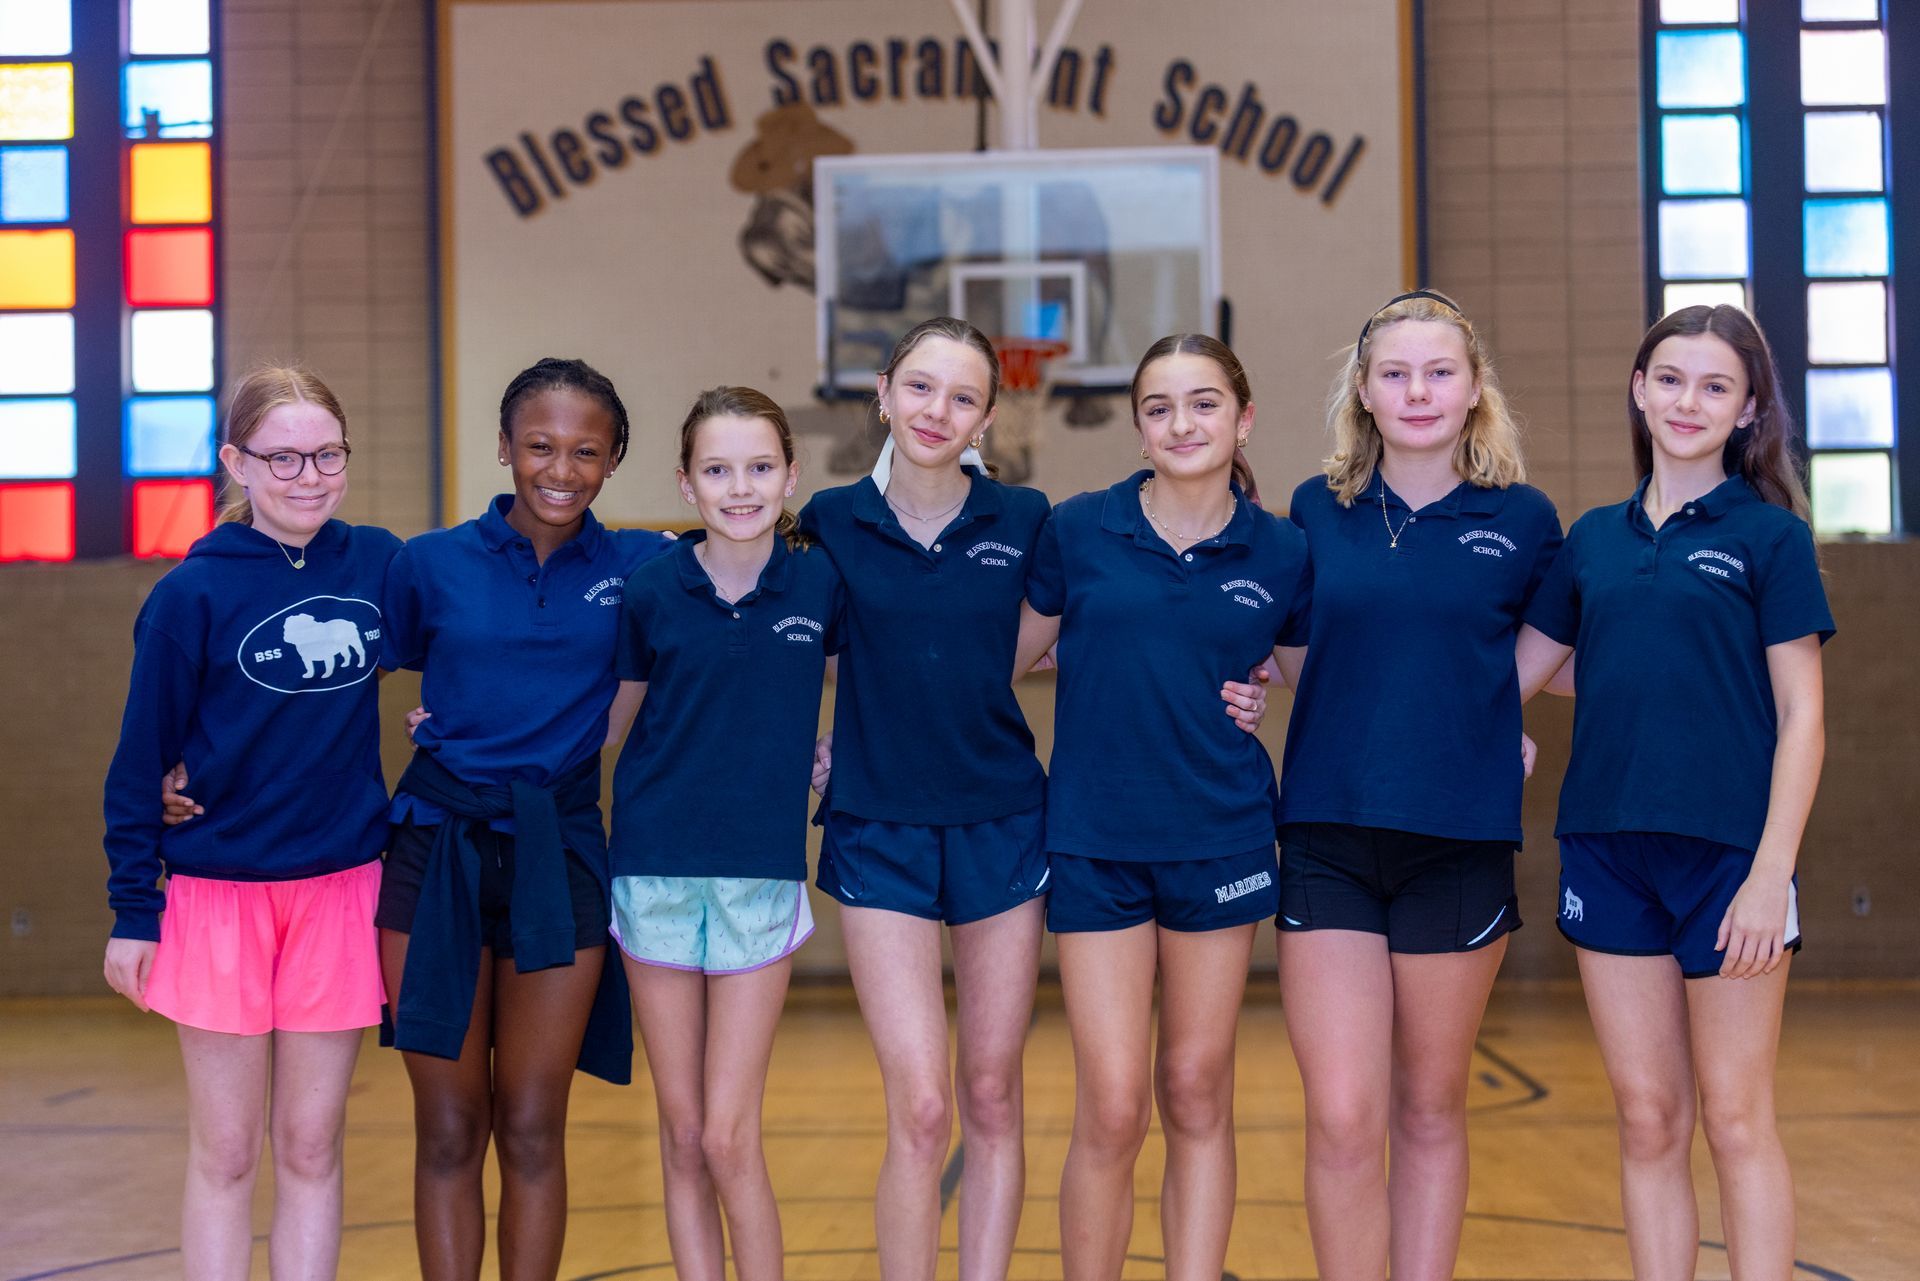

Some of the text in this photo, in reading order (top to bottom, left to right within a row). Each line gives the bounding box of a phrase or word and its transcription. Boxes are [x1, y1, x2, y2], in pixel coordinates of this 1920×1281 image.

[484, 35, 1369, 220] Blessed Sacramnt School
[1458, 529, 1483, 544] BLESSED
[966, 541, 1023, 558] BLESSED SACRAMENT
[1472, 545, 1502, 557] SCHOOL
[1687, 549, 1713, 561] BLESSED
[981, 557, 1008, 567] SCHOOL
[1698, 563, 1730, 578] SCHOOL
[583, 579, 610, 602] BLESSED
[1220, 579, 1246, 592] BLESSED
[1233, 594, 1260, 609] SCHOOL
[772, 616, 797, 633] BLESSED
[786, 633, 813, 642] SCHOOL
[254, 648, 283, 663] BSS
[1214, 871, 1272, 904] MARINES
